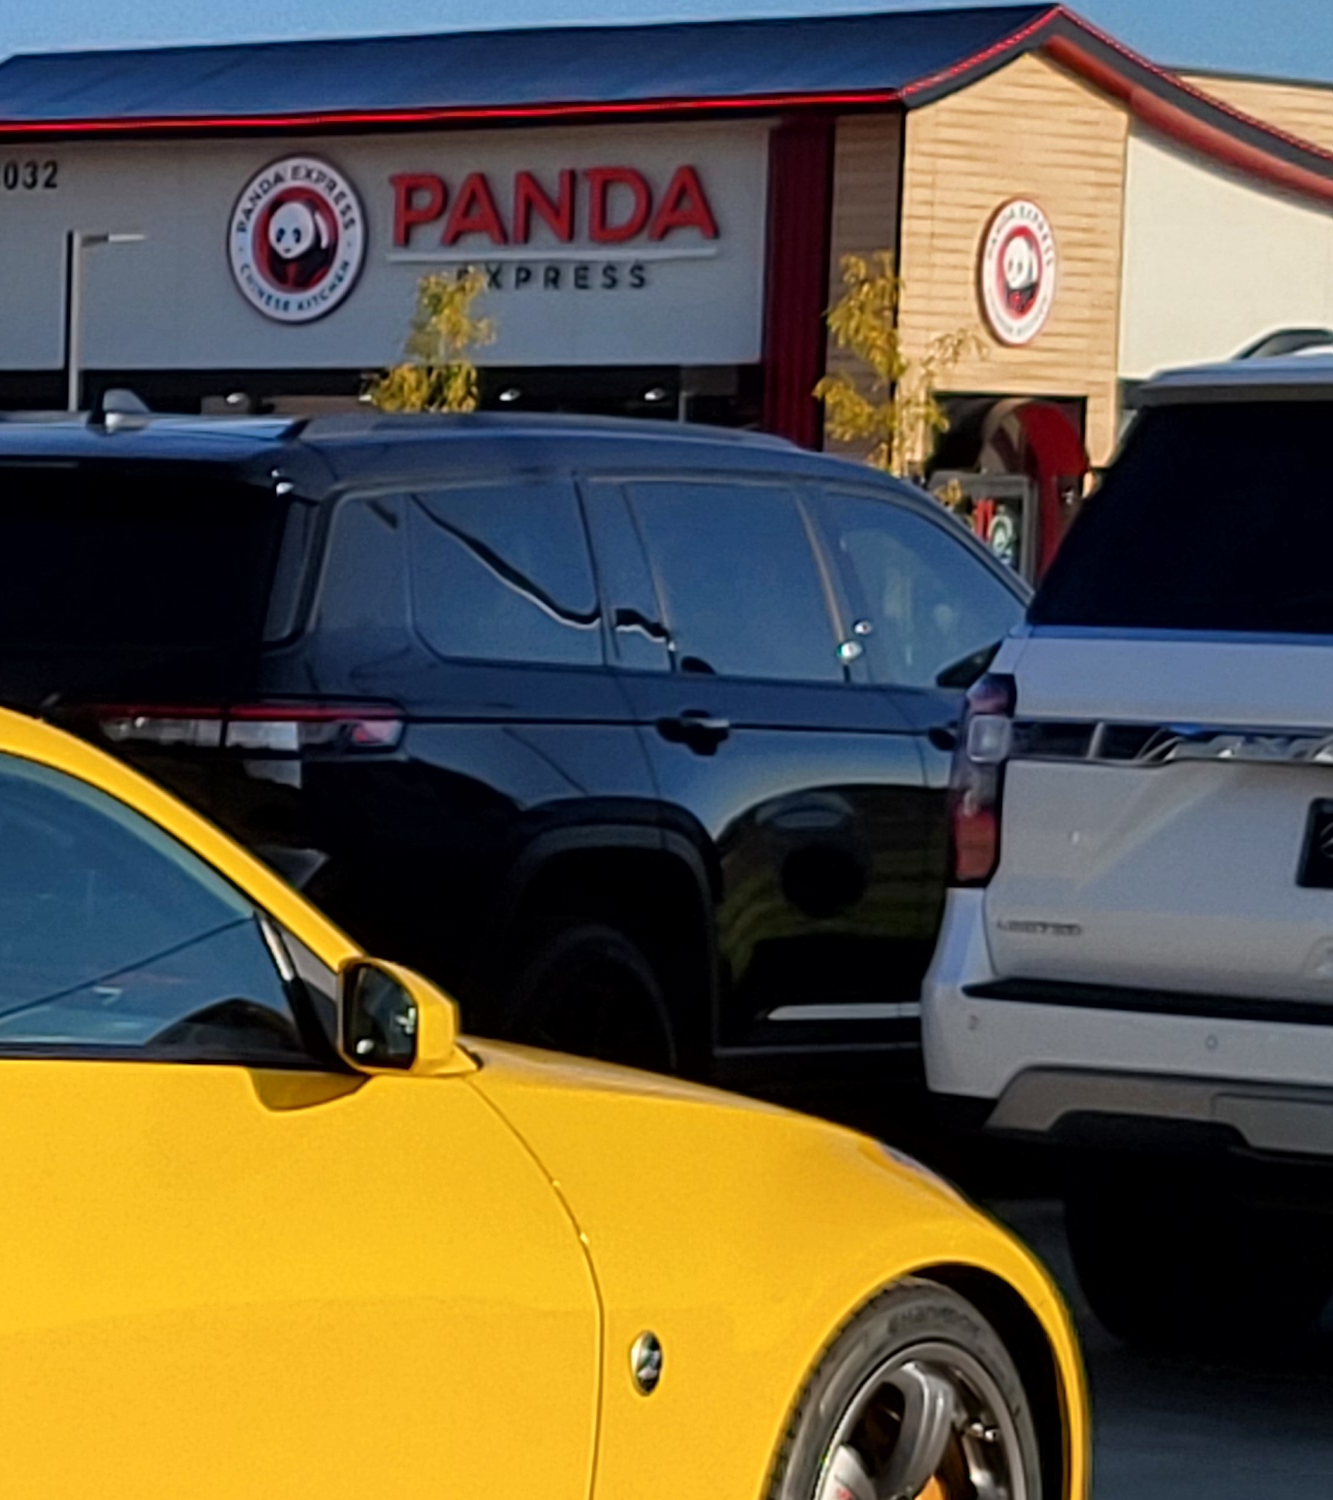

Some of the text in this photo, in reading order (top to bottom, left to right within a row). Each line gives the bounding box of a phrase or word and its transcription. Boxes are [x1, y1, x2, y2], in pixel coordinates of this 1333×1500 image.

[237, 165, 356, 233] PANDA EXPRESS
[388, 165, 720, 246] PANDA
[240, 261, 349, 312] CHINESE KITCHEN
